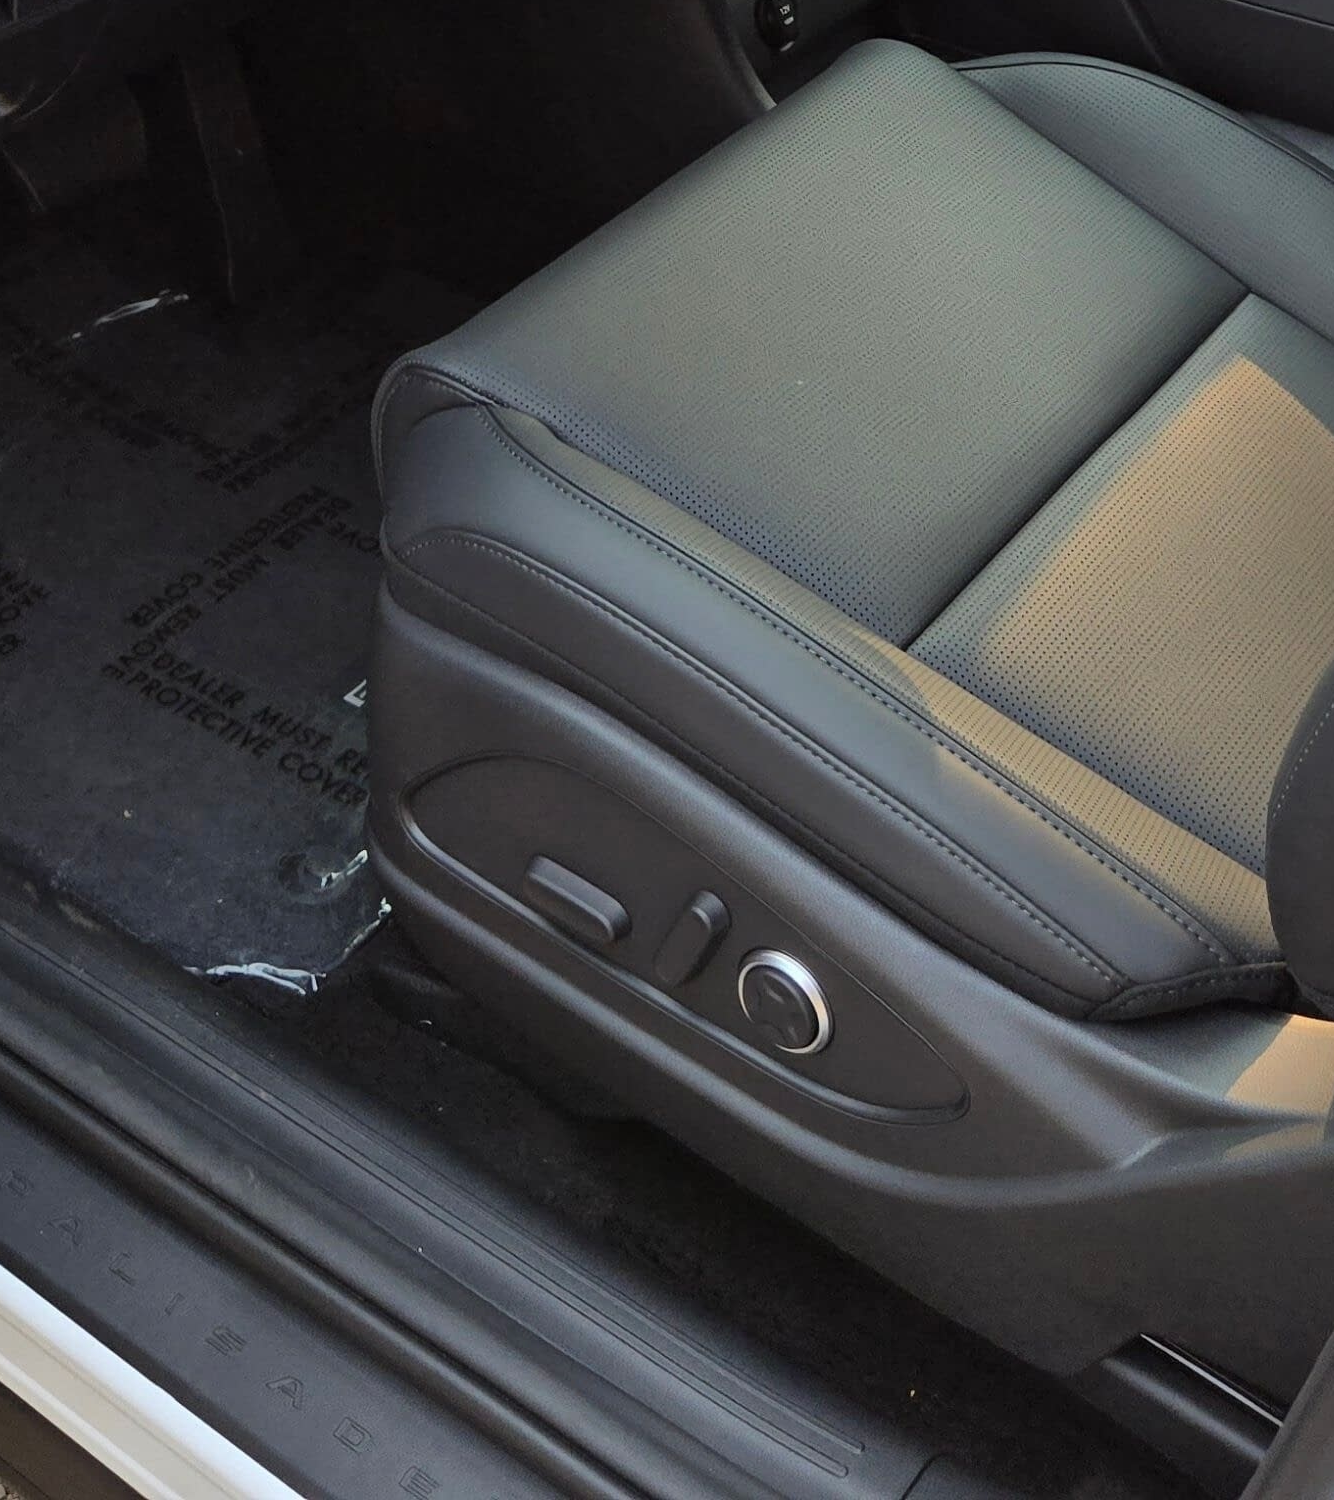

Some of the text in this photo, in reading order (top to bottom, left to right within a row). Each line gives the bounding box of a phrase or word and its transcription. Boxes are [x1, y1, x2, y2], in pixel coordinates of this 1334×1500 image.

[127, 668, 276, 759] PROTECTIVE
[153, 652, 332, 751] DEALER MUST
